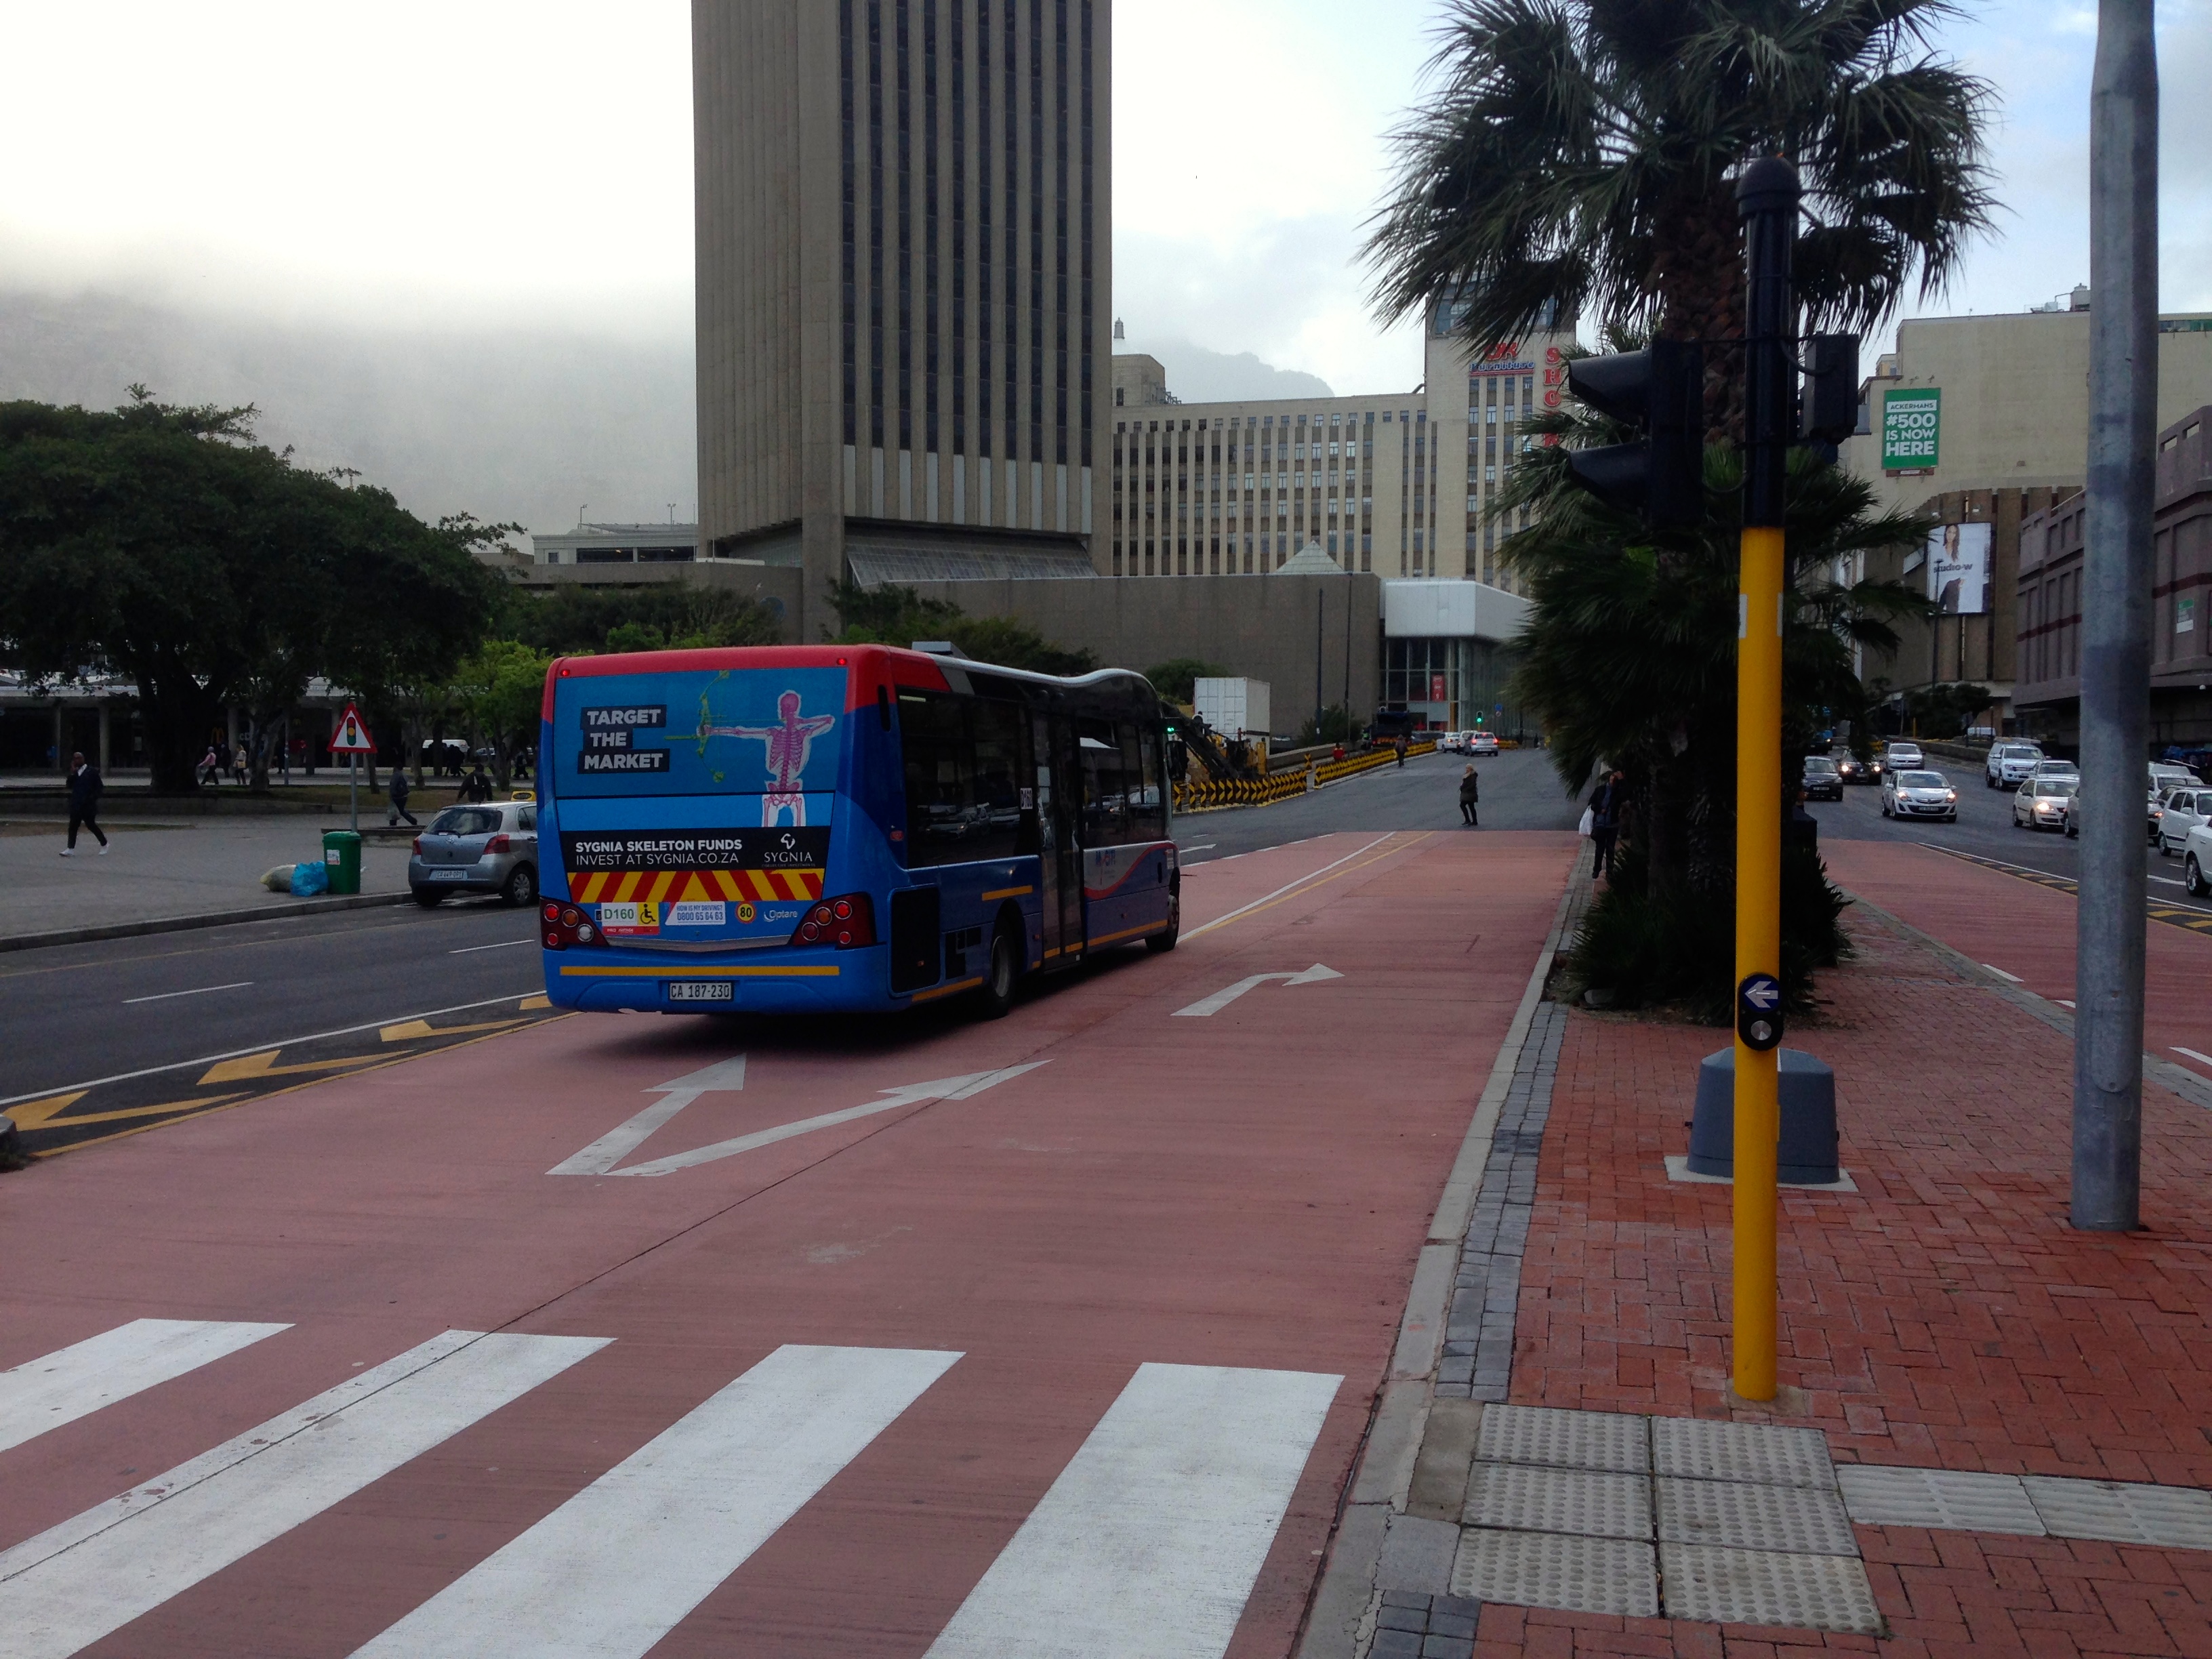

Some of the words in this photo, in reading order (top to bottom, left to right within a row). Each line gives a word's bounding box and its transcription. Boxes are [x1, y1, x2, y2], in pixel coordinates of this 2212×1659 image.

[1890, 402, 1934, 411] ACKERMANS
[1886, 413, 1936, 428] #500
[1885, 429, 1899, 441] IS
[1901, 428, 1936, 441] NOW
[1885, 441, 1936, 457] HERE
[587, 709, 661, 725] TARGET
[590, 731, 628, 747] THE
[584, 753, 663, 770] MARKET
[575, 841, 623, 853] SYGNIA
[626, 840, 695, 852] SKELETON
[697, 839, 743, 851] FUNDS
[576, 854, 621, 865] INVEST
[626, 854, 642, 865] AT
[647, 853, 739, 865] SYGNIA.CO.ZA
[764, 851, 813, 863] SYGNIA
[604, 909, 634, 920] D160
[677, 912, 694, 920] 0800
[740, 906, 752, 918] 80
[671, 985, 683, 998] CA
[688, 985, 729, 998] 187-230
